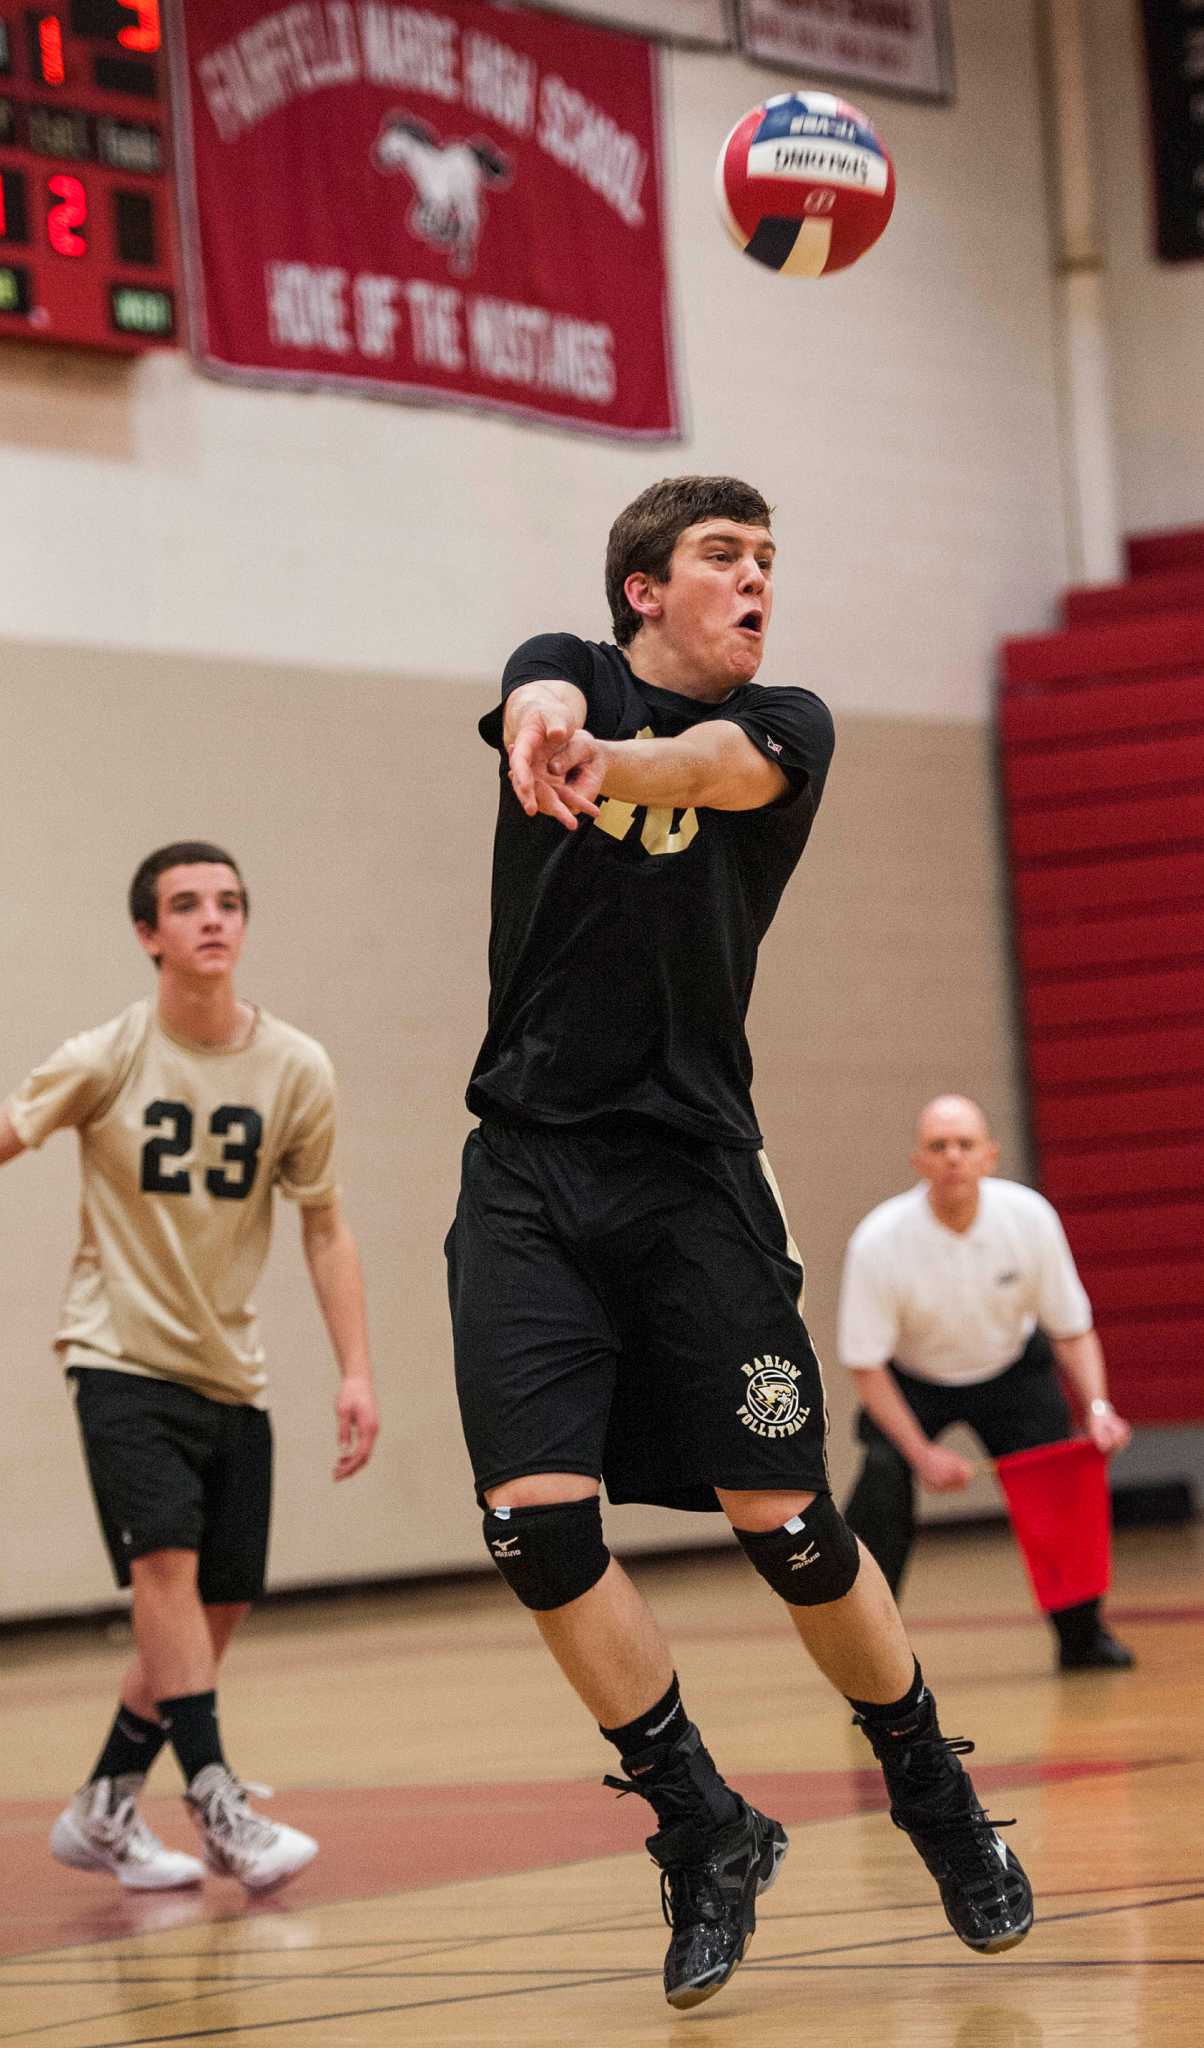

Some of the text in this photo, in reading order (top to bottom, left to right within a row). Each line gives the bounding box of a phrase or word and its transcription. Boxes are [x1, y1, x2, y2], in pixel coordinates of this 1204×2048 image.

[463, 29, 537, 138] HIGH
[539, 74, 645, 227] SCHOOL
[48, 176, 87, 257] 2
[267, 263, 350, 355] HOME
[352, 273, 400, 359] OF
[405, 280, 465, 372] THE
[468, 298, 617, 405] MUSTANGS
[141, 1100, 263, 1200] 23
[741, 1355, 802, 1380] BARLOW
[736, 1405, 810, 1438] VOLLEYBALL
